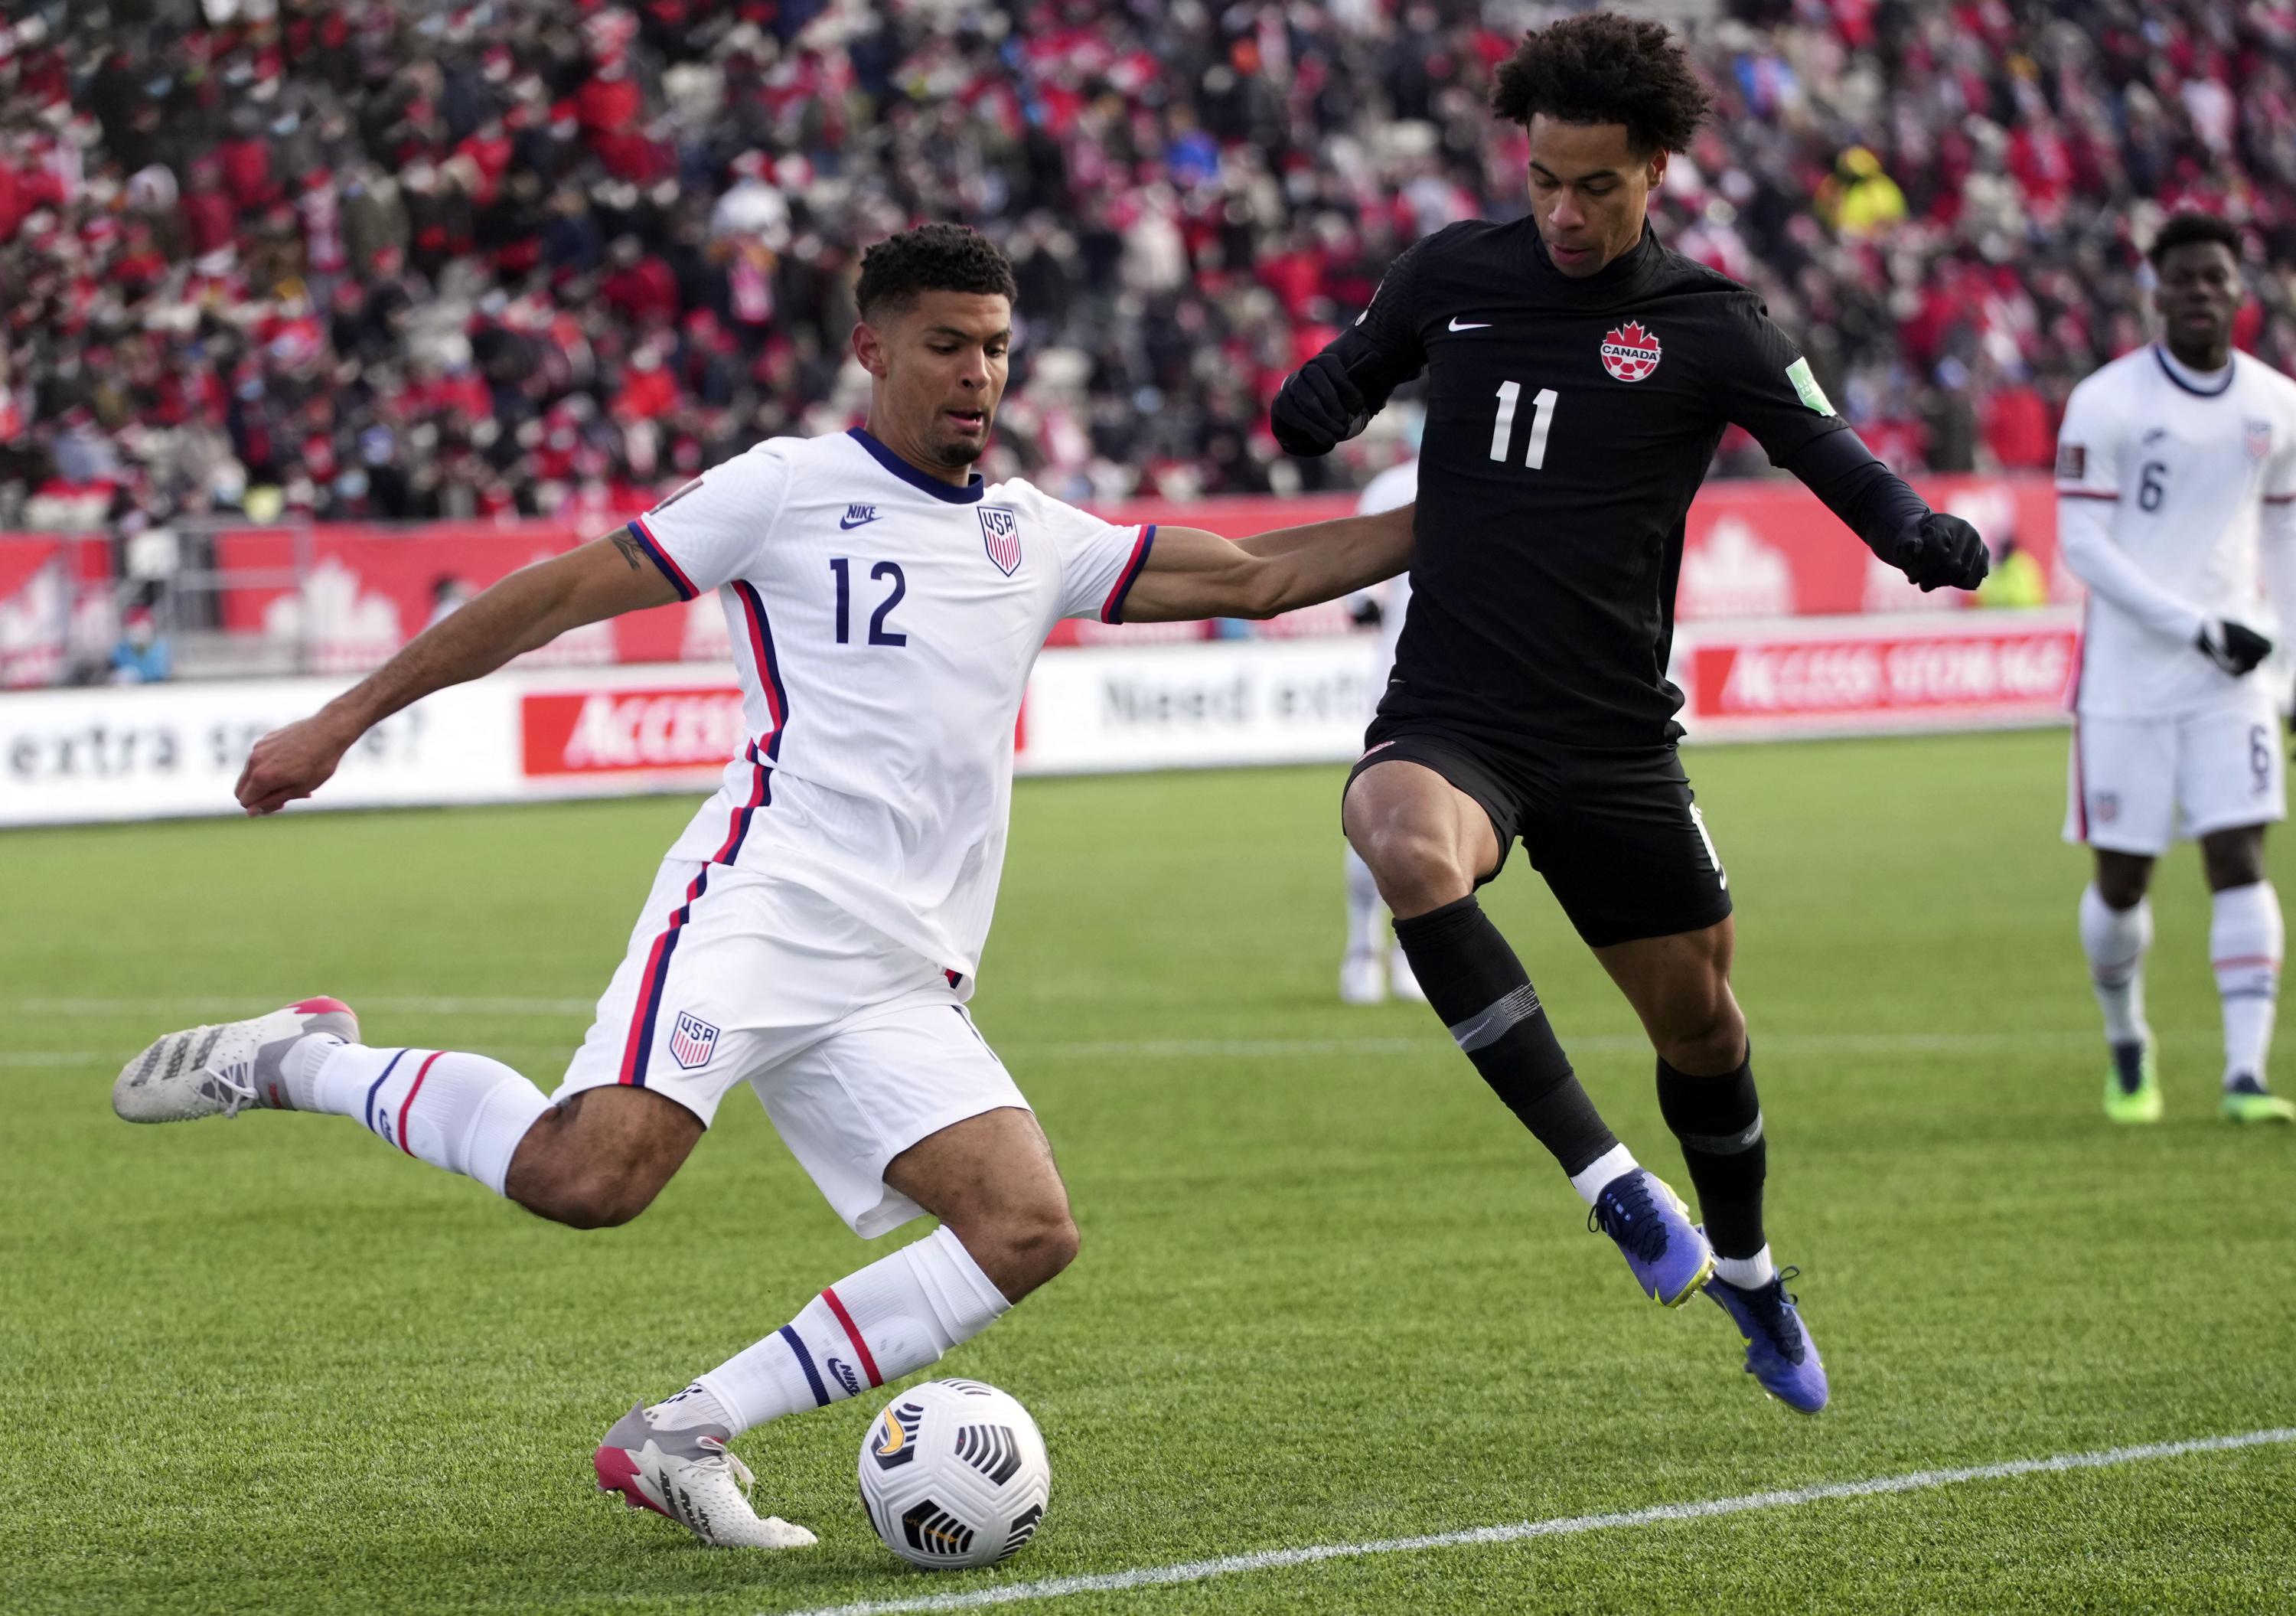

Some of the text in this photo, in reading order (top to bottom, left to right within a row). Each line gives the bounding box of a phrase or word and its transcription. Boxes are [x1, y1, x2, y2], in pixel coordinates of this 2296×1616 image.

[1602, 345, 1657, 361] CANADA
[1489, 380, 1559, 469] 11
[846, 504, 876, 519] NIKE
[2140, 461, 2167, 514] 6
[983, 511, 1014, 536] USA
[830, 558, 907, 647] 12
[1274, 671, 1368, 722] ext
[9, 721, 179, 776] extra
[2249, 724, 2270, 775] 6
[681, 1017, 714, 1041] USA
[840, 1364, 861, 1394] NIKE
